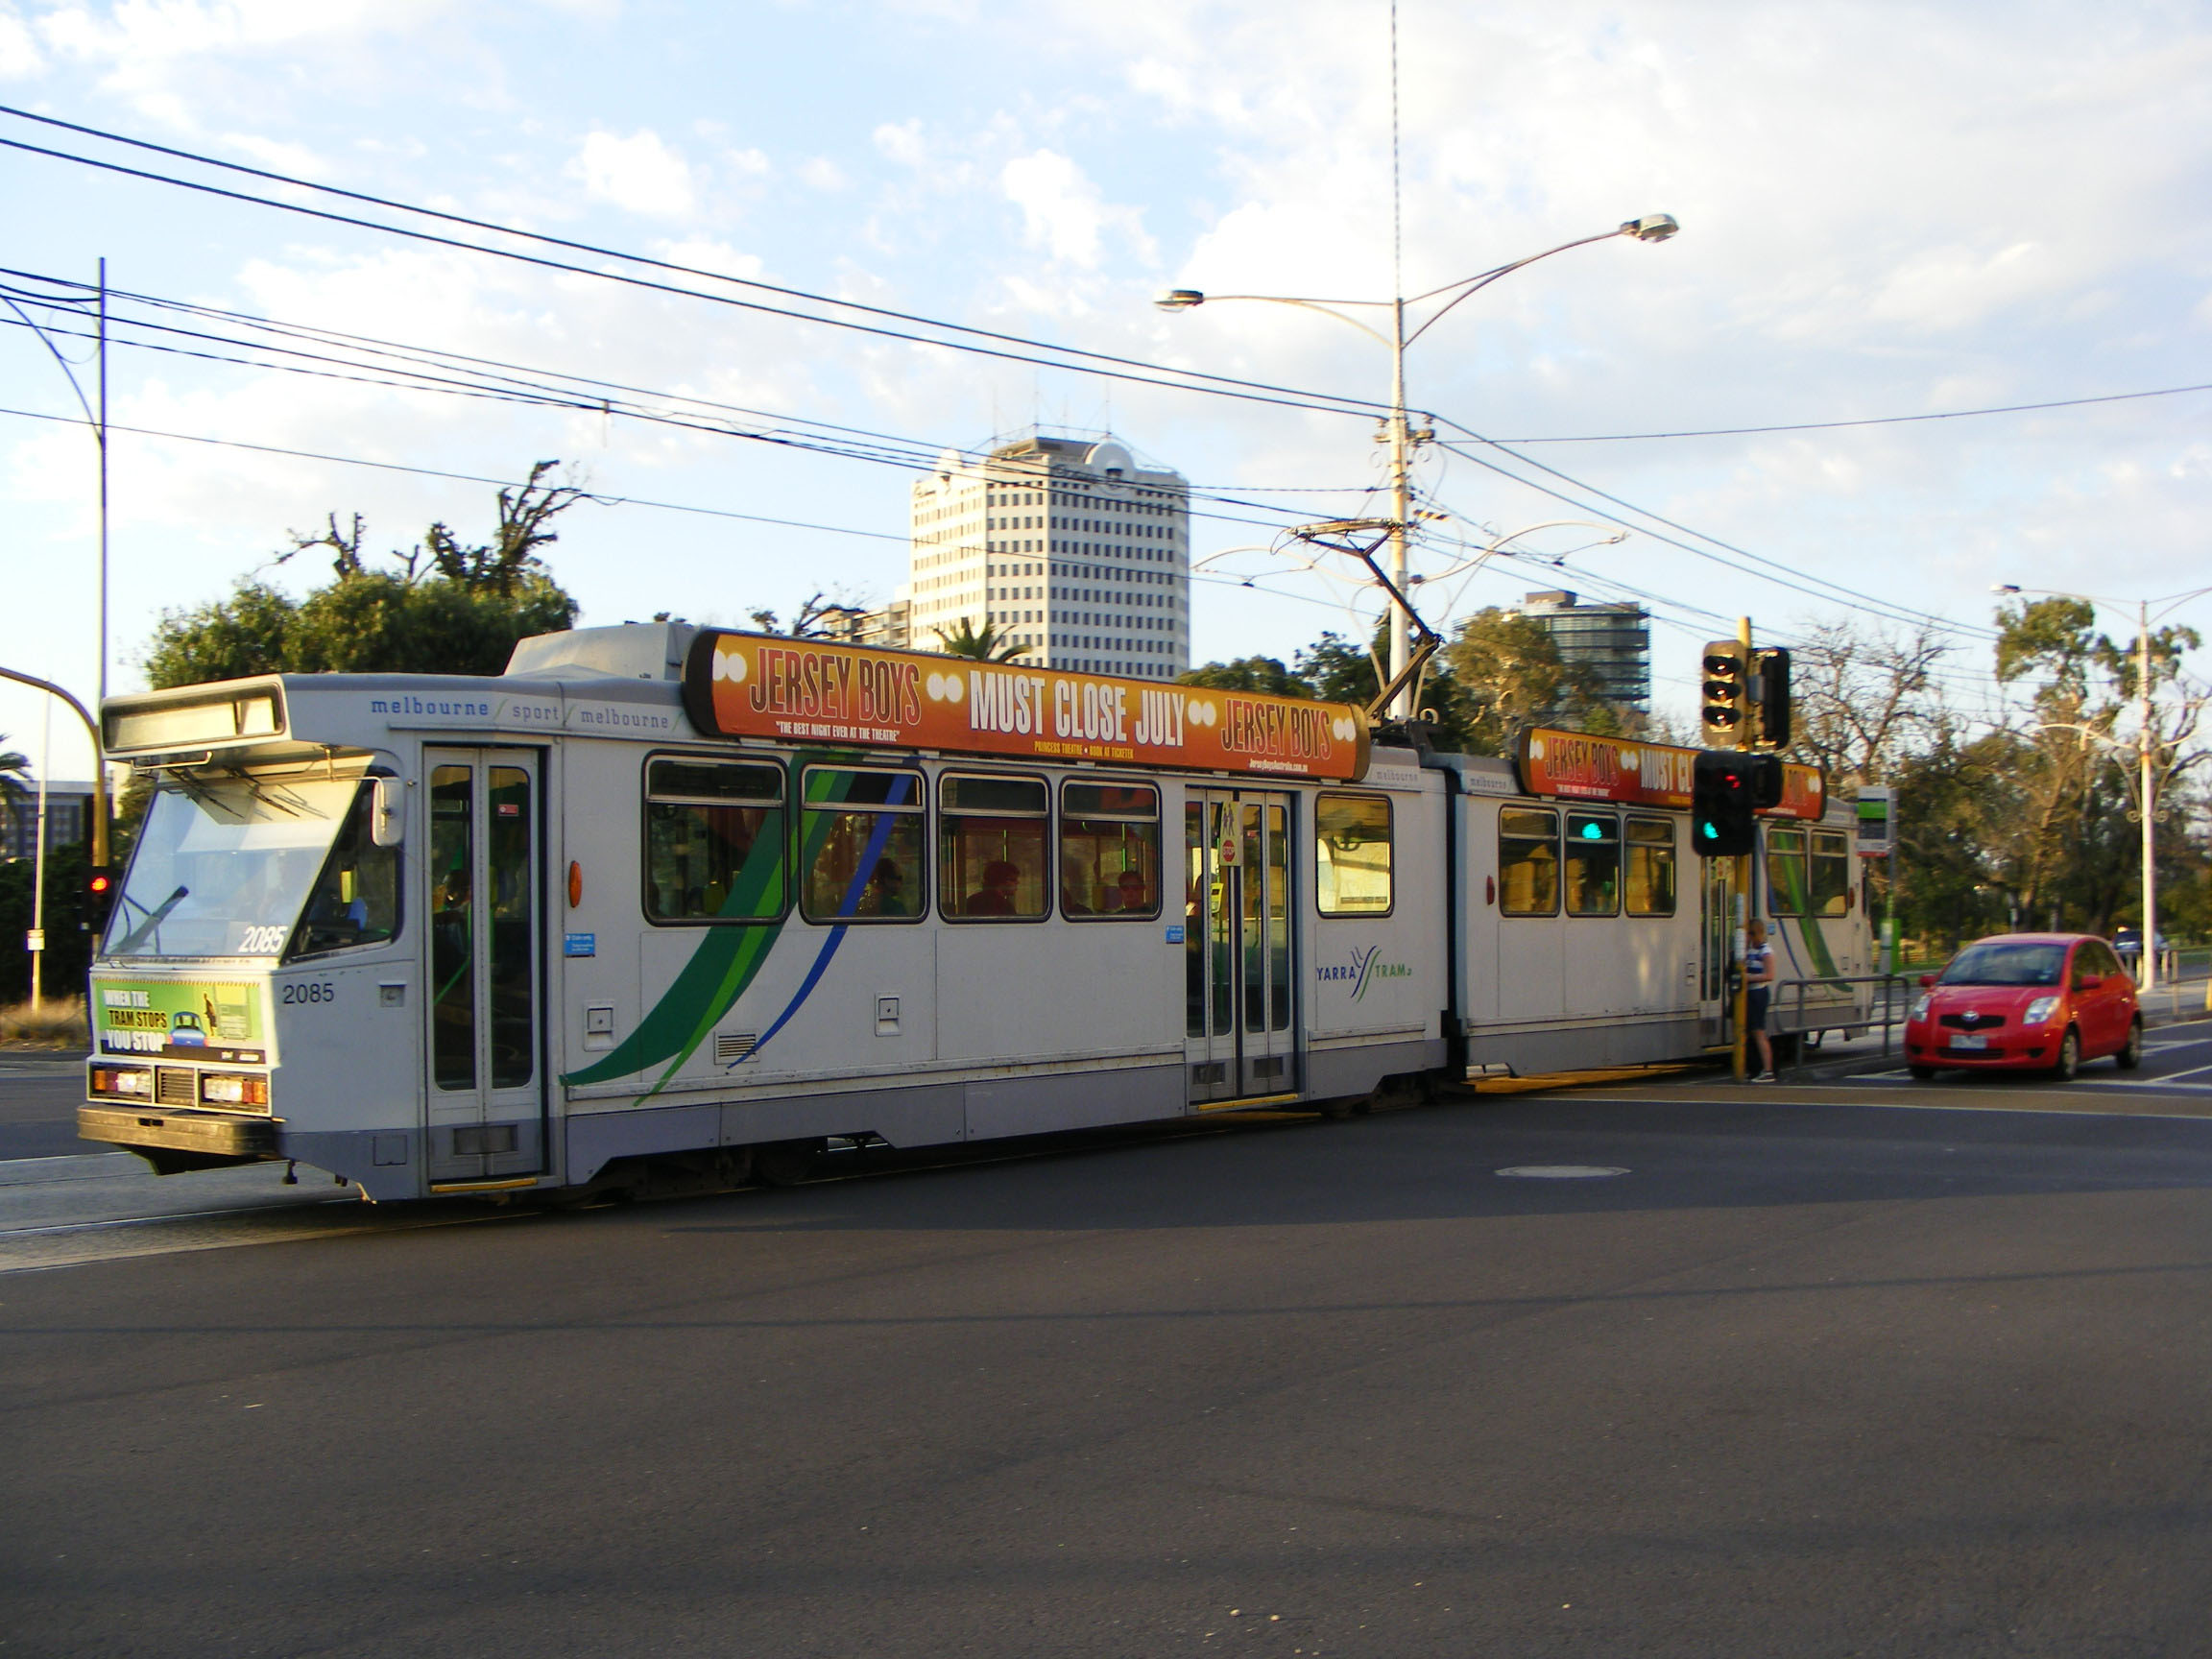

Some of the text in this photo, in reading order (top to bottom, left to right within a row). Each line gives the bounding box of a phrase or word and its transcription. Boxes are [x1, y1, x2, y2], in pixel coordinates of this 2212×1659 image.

[750, 646, 922, 726] JERSEY BOYS
[371, 697, 490, 716] melbourne
[513, 705, 559, 721] sport
[969, 669, 1186, 747] MUST CLOSE JULY
[581, 707, 669, 729] melbourne
[1221, 698, 1332, 759] JERSEY BOYS
[793, 722, 809, 735] BEST
[811, 723, 831, 737] NIGHT
[832, 725, 849, 738] EVER
[850, 727, 857, 739] AT
[858, 727, 871, 740] THE
[1545, 737, 1620, 786] JERSEY BOYS
[1640, 749, 1674, 791] MUST
[238, 926, 288, 953] 2085
[1316, 966, 1357, 981] YARRA
[103, 989, 150, 1008] WHEN THE
[282, 983, 334, 1004] 2085
[108, 1010, 168, 1028] TRAM STOPS
[106, 1029, 166, 1052] YOU STOP
